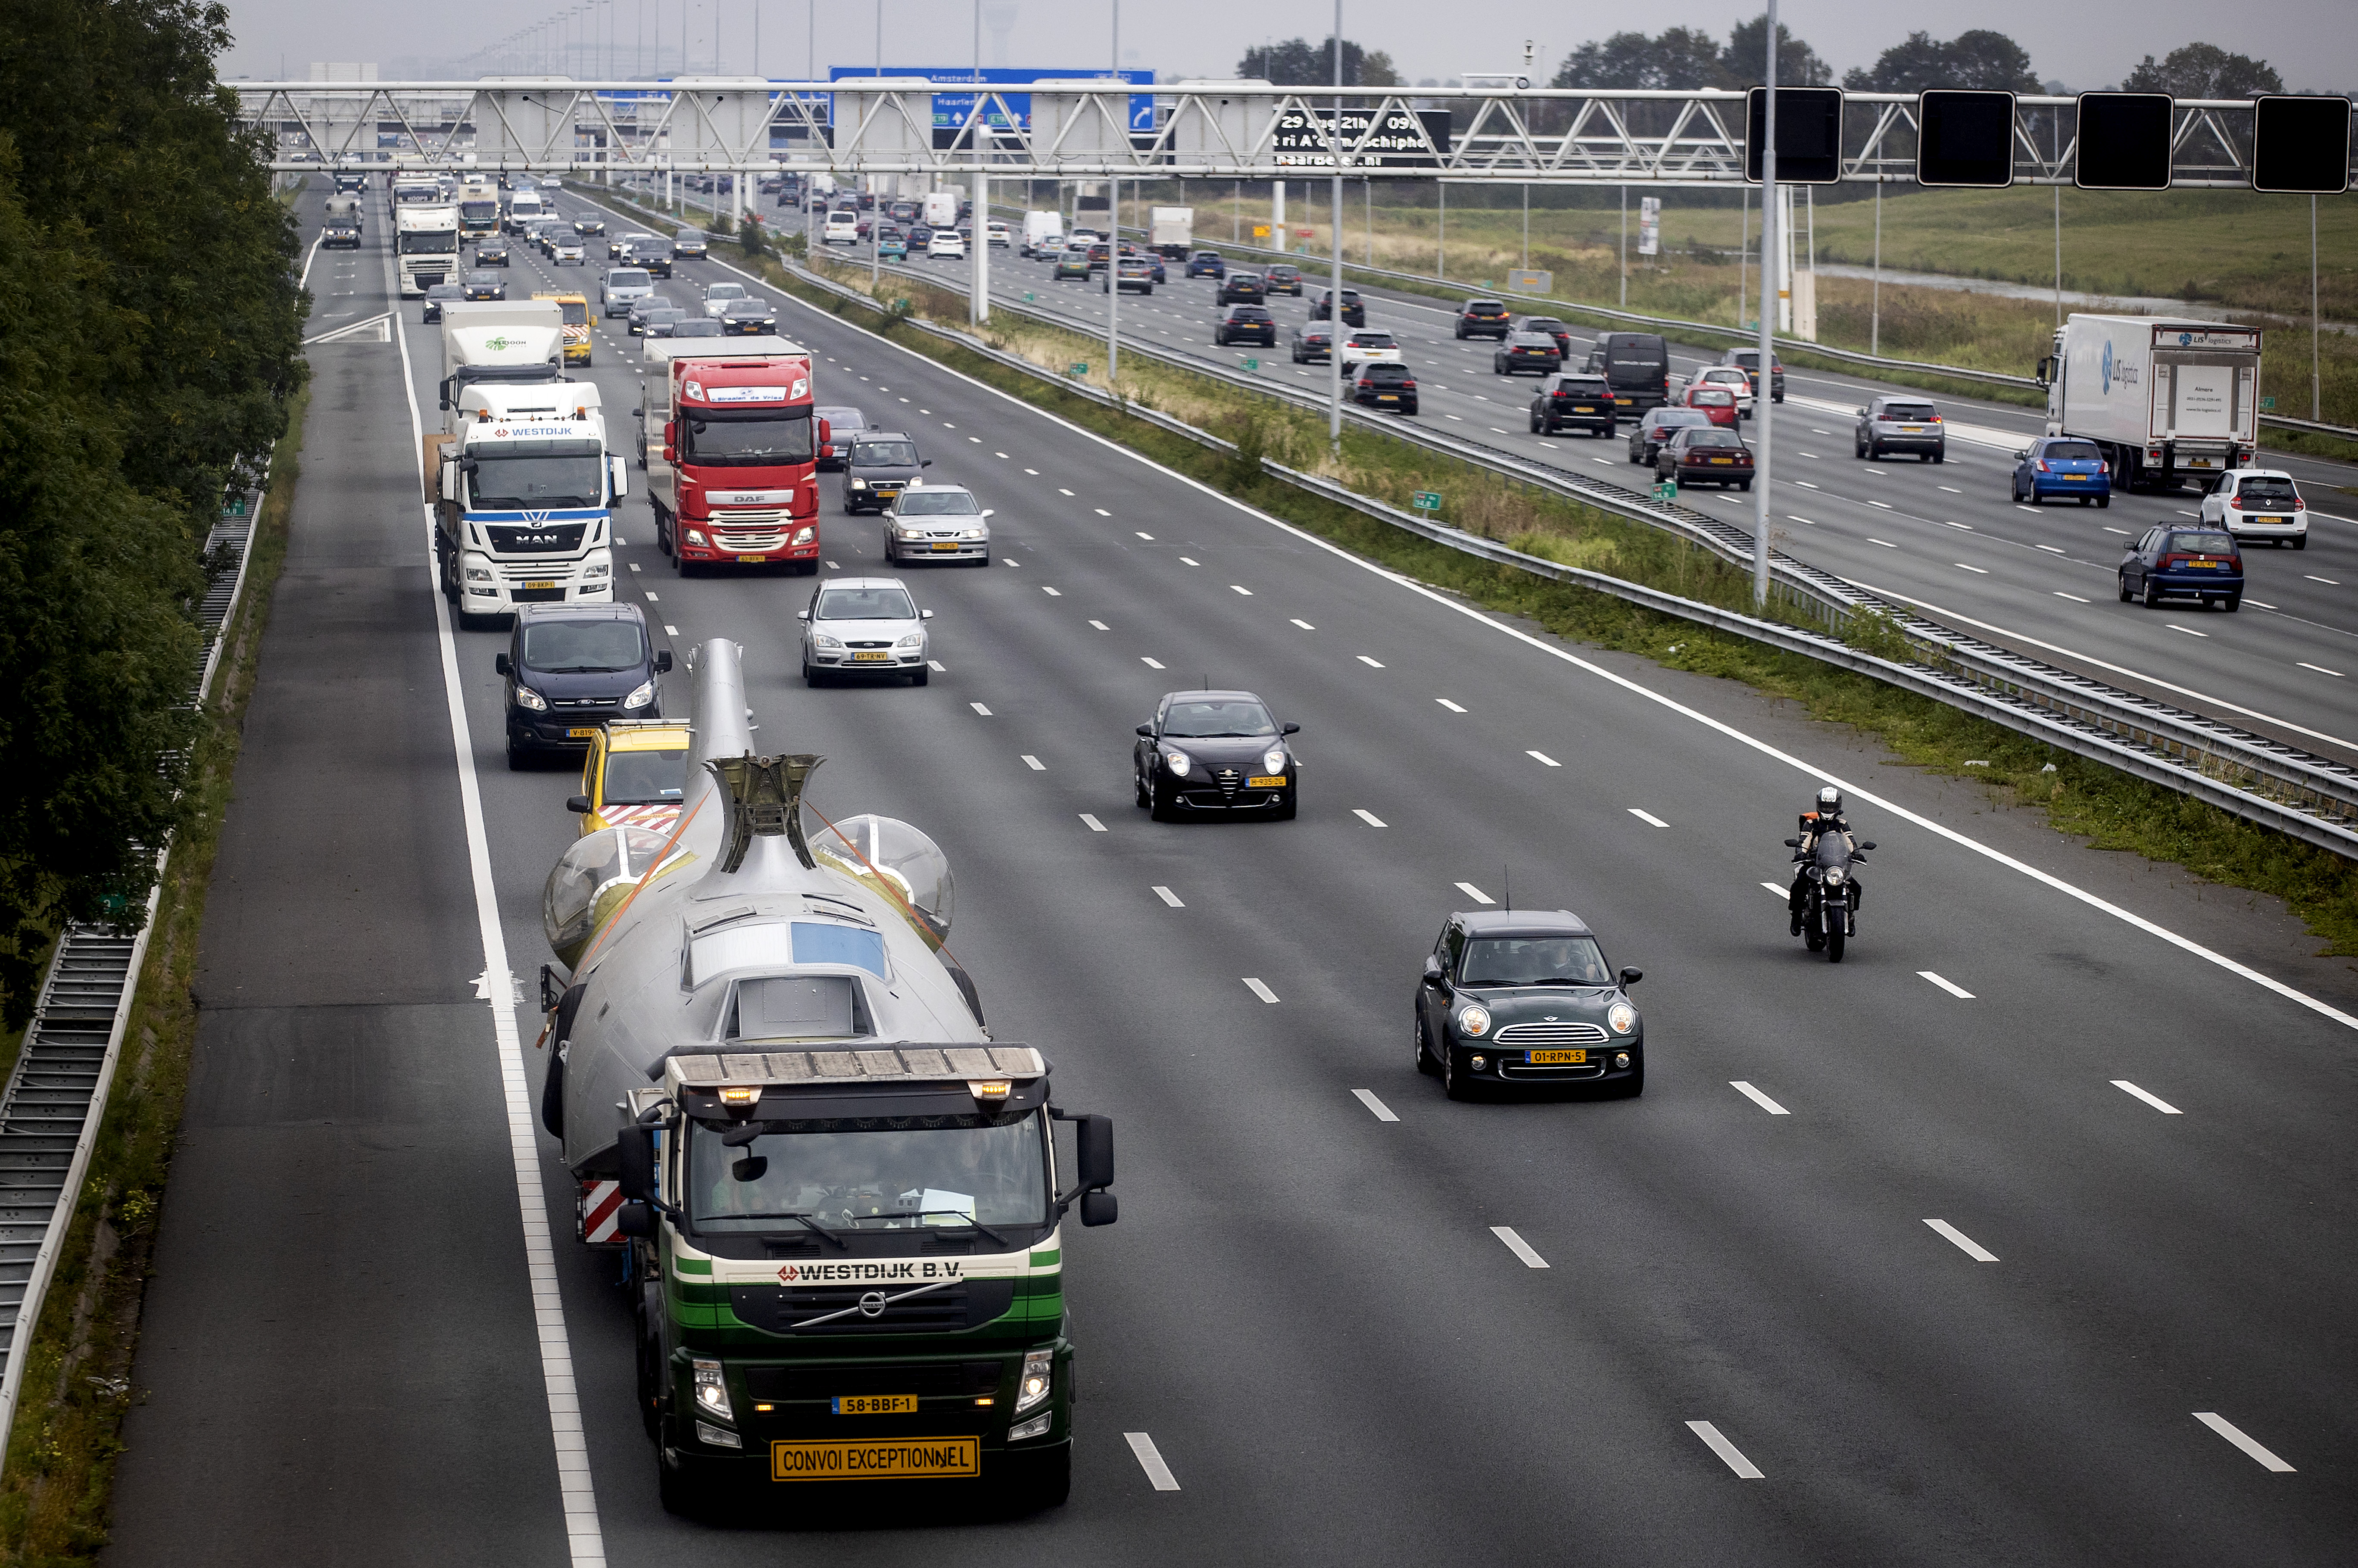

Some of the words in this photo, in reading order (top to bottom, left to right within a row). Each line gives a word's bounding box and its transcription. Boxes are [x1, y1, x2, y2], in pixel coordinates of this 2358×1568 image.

[1281, 116, 1304, 128] 29
[1341, 116, 1369, 129] 21h
[1282, 134, 1296, 147] ri
[2121, 360, 2138, 390] logistics
[516, 535, 557, 544] MAN
[1535, 1052, 1581, 1061] 01-RPN-5
[799, 1263, 914, 1281] WESTDIJK
[923, 1262, 964, 1278] B.V.
[847, 1398, 910, 1412] 58-BBF-1
[783, 1450, 842, 1471] CONVOI
[848, 1446, 969, 1470] EXCEPTIONNEL
